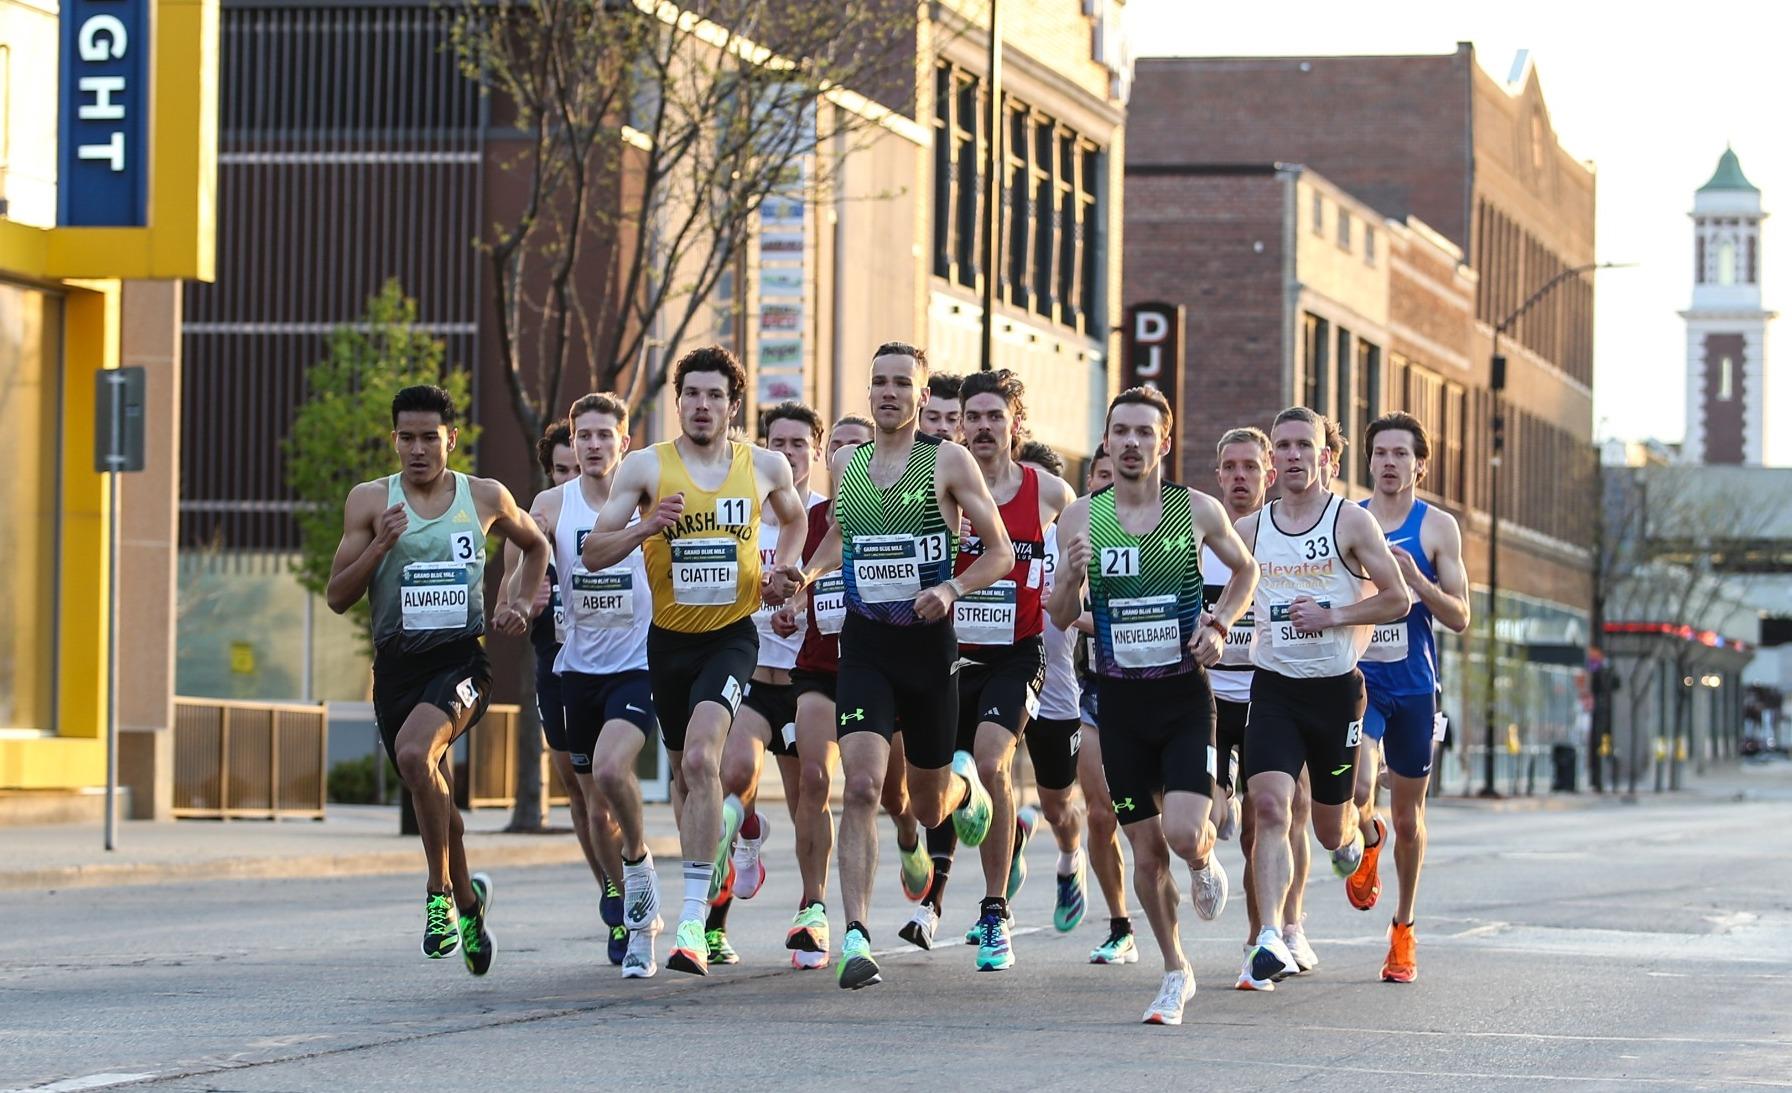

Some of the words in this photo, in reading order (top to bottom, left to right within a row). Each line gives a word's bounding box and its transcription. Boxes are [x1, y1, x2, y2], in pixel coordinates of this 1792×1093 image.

[1135, 311, 1168, 386] DJ
[723, 499, 744, 523] 11
[456, 536, 473, 560] 3
[919, 535, 942, 561] 13
[1305, 536, 1330, 560] 33
[858, 563, 915, 580] COMBER
[1106, 549, 1131, 575] 21
[1260, 558, 1333, 577] Elevated
[680, 567, 730, 582] CIATTEI
[404, 589, 466, 607] ALVARADO
[582, 595, 623, 609] ABERT
[957, 607, 1011, 623] STREICH
[1114, 626, 1178, 645] KNEVELBAARD
